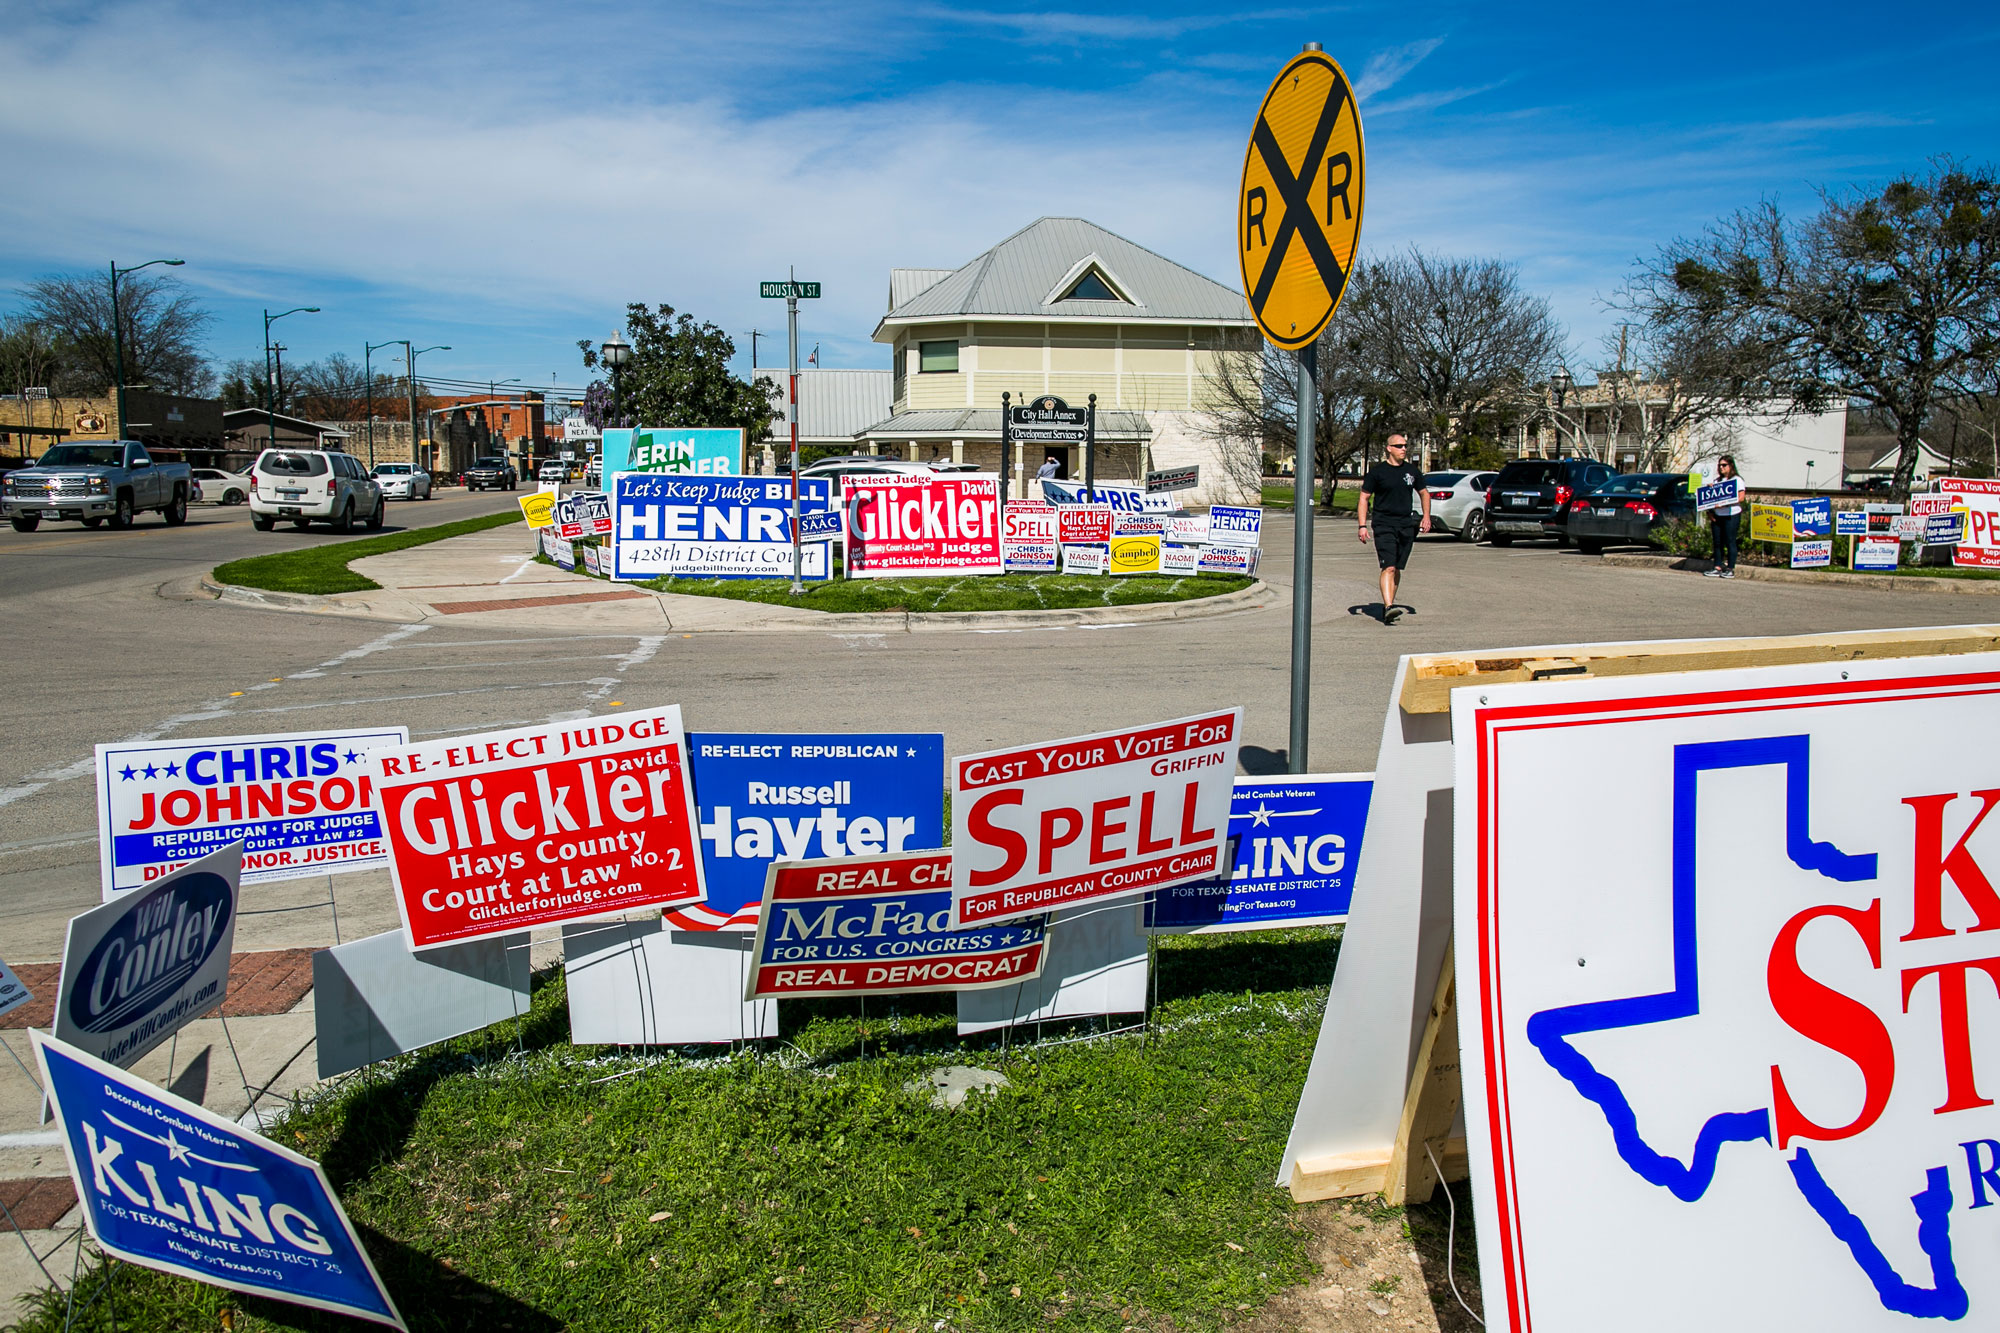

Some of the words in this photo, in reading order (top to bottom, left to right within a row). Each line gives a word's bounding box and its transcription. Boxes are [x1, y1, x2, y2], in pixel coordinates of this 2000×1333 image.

[1247, 186, 1267, 251] R
[1327, 152, 1352, 226] R
[763, 284, 804, 296] HOUSTON
[1022, 410, 1037, 420] City
[1039, 410, 1053, 419] Hall
[1054, 410, 1076, 420] Annex
[1015, 429, 1052, 439] Development
[1053, 430, 1076, 439] Services
[637, 438, 695, 467] ERIN
[842, 476, 890, 485] Re-elect
[894, 475, 931, 485] Judge
[961, 480, 995, 496] David
[1148, 472, 1186, 482] MARY
[1149, 478, 1196, 491] WILSON
[1942, 480, 1960, 490] CAST
[1962, 481, 1984, 491] YOUR
[622, 478, 662, 497] Let's
[665, 481, 708, 504] Keep
[709, 481, 760, 505] Judge
[1701, 484, 1733, 500] ISAAC
[850, 488, 995, 541] Glickler
[1061, 511, 1109, 526] Glickler
[1794, 511, 1828, 524] Hayter
[1913, 501, 1949, 514] Glickler
[802, 517, 837, 531] SAAC
[1006, 514, 1053, 537] SPELL
[1211, 515, 1259, 532] HENRY
[628, 543, 680, 564] 428th
[688, 545, 756, 562] District
[942, 543, 993, 554] Judge
[1069, 552, 1099, 562] NAOMI
[1113, 547, 1156, 559] Campbell
[1165, 554, 1194, 562] NAOMI
[1201, 554, 1246, 562] JOHNSON
[670, 564, 778, 573] judgebillhenry.com
[853, 556, 998, 567] www.glicklerforjudge.com
[381, 735, 548, 777] RE-ELECT
[561, 717, 670, 756] JUDGE
[701, 745, 783, 758] RE-ELECT
[791, 745, 898, 758] REPUBLICAN
[964, 760, 1028, 786] CAST
[1036, 748, 1105, 773] YOUR
[1114, 734, 1175, 760] VOTE
[1184, 723, 1227, 746] FOR
[185, 743, 339, 786] CHRIS
[600, 749, 667, 774] David
[1150, 751, 1225, 777] GRIFFIN
[748, 781, 851, 805] Russell
[1252, 790, 1283, 799] Combat
[1285, 789, 1316, 798] Veteran
[400, 760, 671, 856] Glickler
[152, 825, 267, 848] REPUBLICAN
[282, 820, 316, 834] FOR
[320, 814, 374, 829] JUDGE
[247, 837, 284, 849] OURT
[291, 835, 308, 845] AT
[314, 831, 343, 842] LAW
[348, 828, 364, 839] #2
[698, 806, 915, 862] Hayter
[966, 781, 1216, 887] SPELL
[303, 841, 387, 863] JUSTICE.
[447, 850, 526, 880] Hays
[536, 830, 646, 864] County
[422, 878, 512, 912] Court
[521, 872, 551, 896] at
[560, 863, 621, 889] Law
[666, 847, 684, 872] 2
[815, 869, 898, 891] REAL
[965, 899, 997, 916] FOR
[1003, 879, 1095, 908] REPUBLICAN
[1100, 865, 1163, 888] COUNTY
[1168, 853, 1213, 874] CHAIR
[1172, 888, 1194, 897] FOR
[1197, 886, 1232, 896] TEXAS
[1235, 883, 1277, 894] SENATE
[1279, 879, 1326, 891] DISTRICT
[1329, 878, 1341, 888] 25
[468, 880, 642, 921] Glicklerforjudge.com
[1218, 899, 1296, 912] KlingForTexas.org
[135, 890, 175, 941] Will
[771, 946, 818, 960] FOR
[825, 945, 867, 957] U.S.
[875, 934, 993, 956] CONGRESS
[1019, 929, 1040, 943] 21
[89, 899, 223, 1016] Conley
[774, 970, 855, 988] REAL
[865, 953, 1030, 984] DEMOCRAT
[104, 1084, 153, 1116] Decorated
[154, 1109, 194, 1135] Combat
[195, 1126, 240, 1149] Veteran
[82, 1120, 333, 1255] KLING
[101, 1199, 129, 1219] FOR
[129, 1210, 179, 1233] TEXAS
[180, 1226, 241, 1253] SENATE
[243, 1244, 319, 1269] DISTRICT
[323, 1260, 343, 1275] 25
[167, 1239, 283, 1281] KlingForTexas.org
